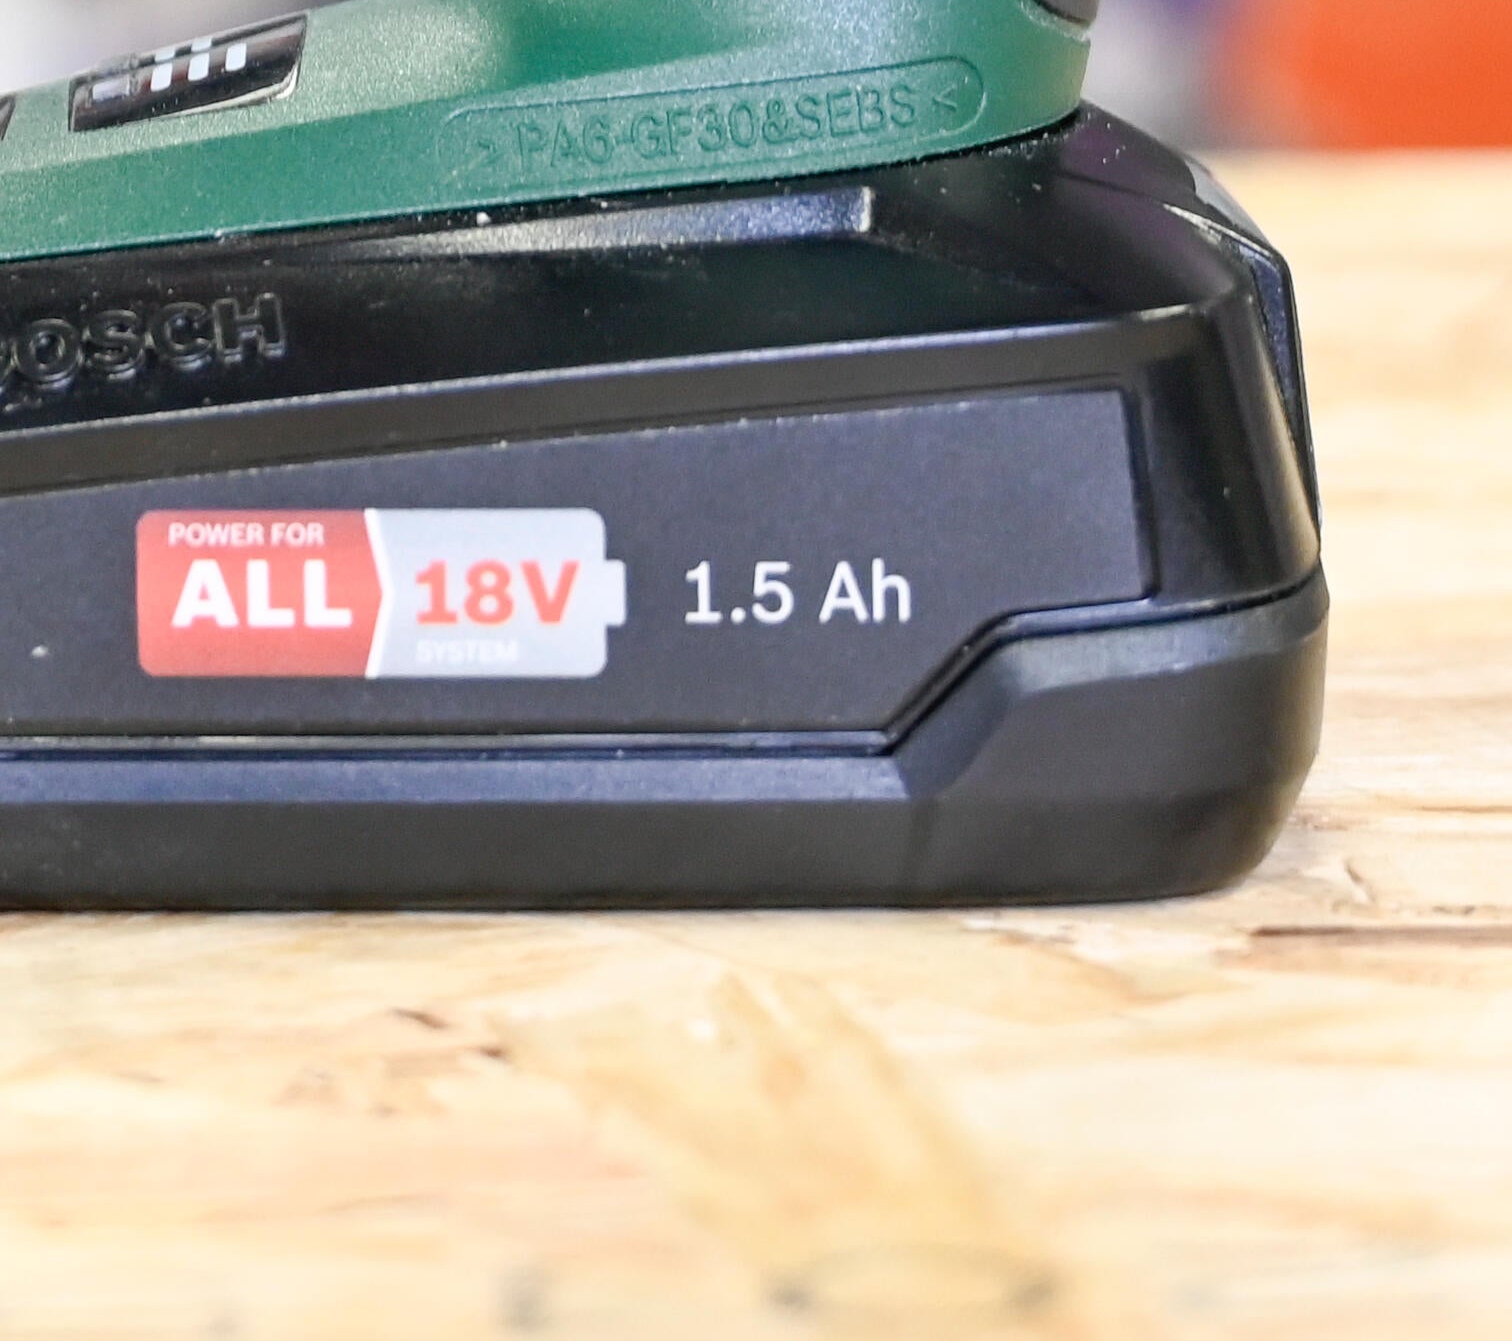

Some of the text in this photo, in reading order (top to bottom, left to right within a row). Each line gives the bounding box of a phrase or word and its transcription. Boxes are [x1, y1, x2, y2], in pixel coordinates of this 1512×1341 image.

[167, 521, 325, 548] POWER FOR
[171, 558, 354, 629] ALL
[414, 558, 581, 627] 18V
[684, 556, 912, 625] 1.5 Ah
[414, 638, 521, 664] SYSTEM
